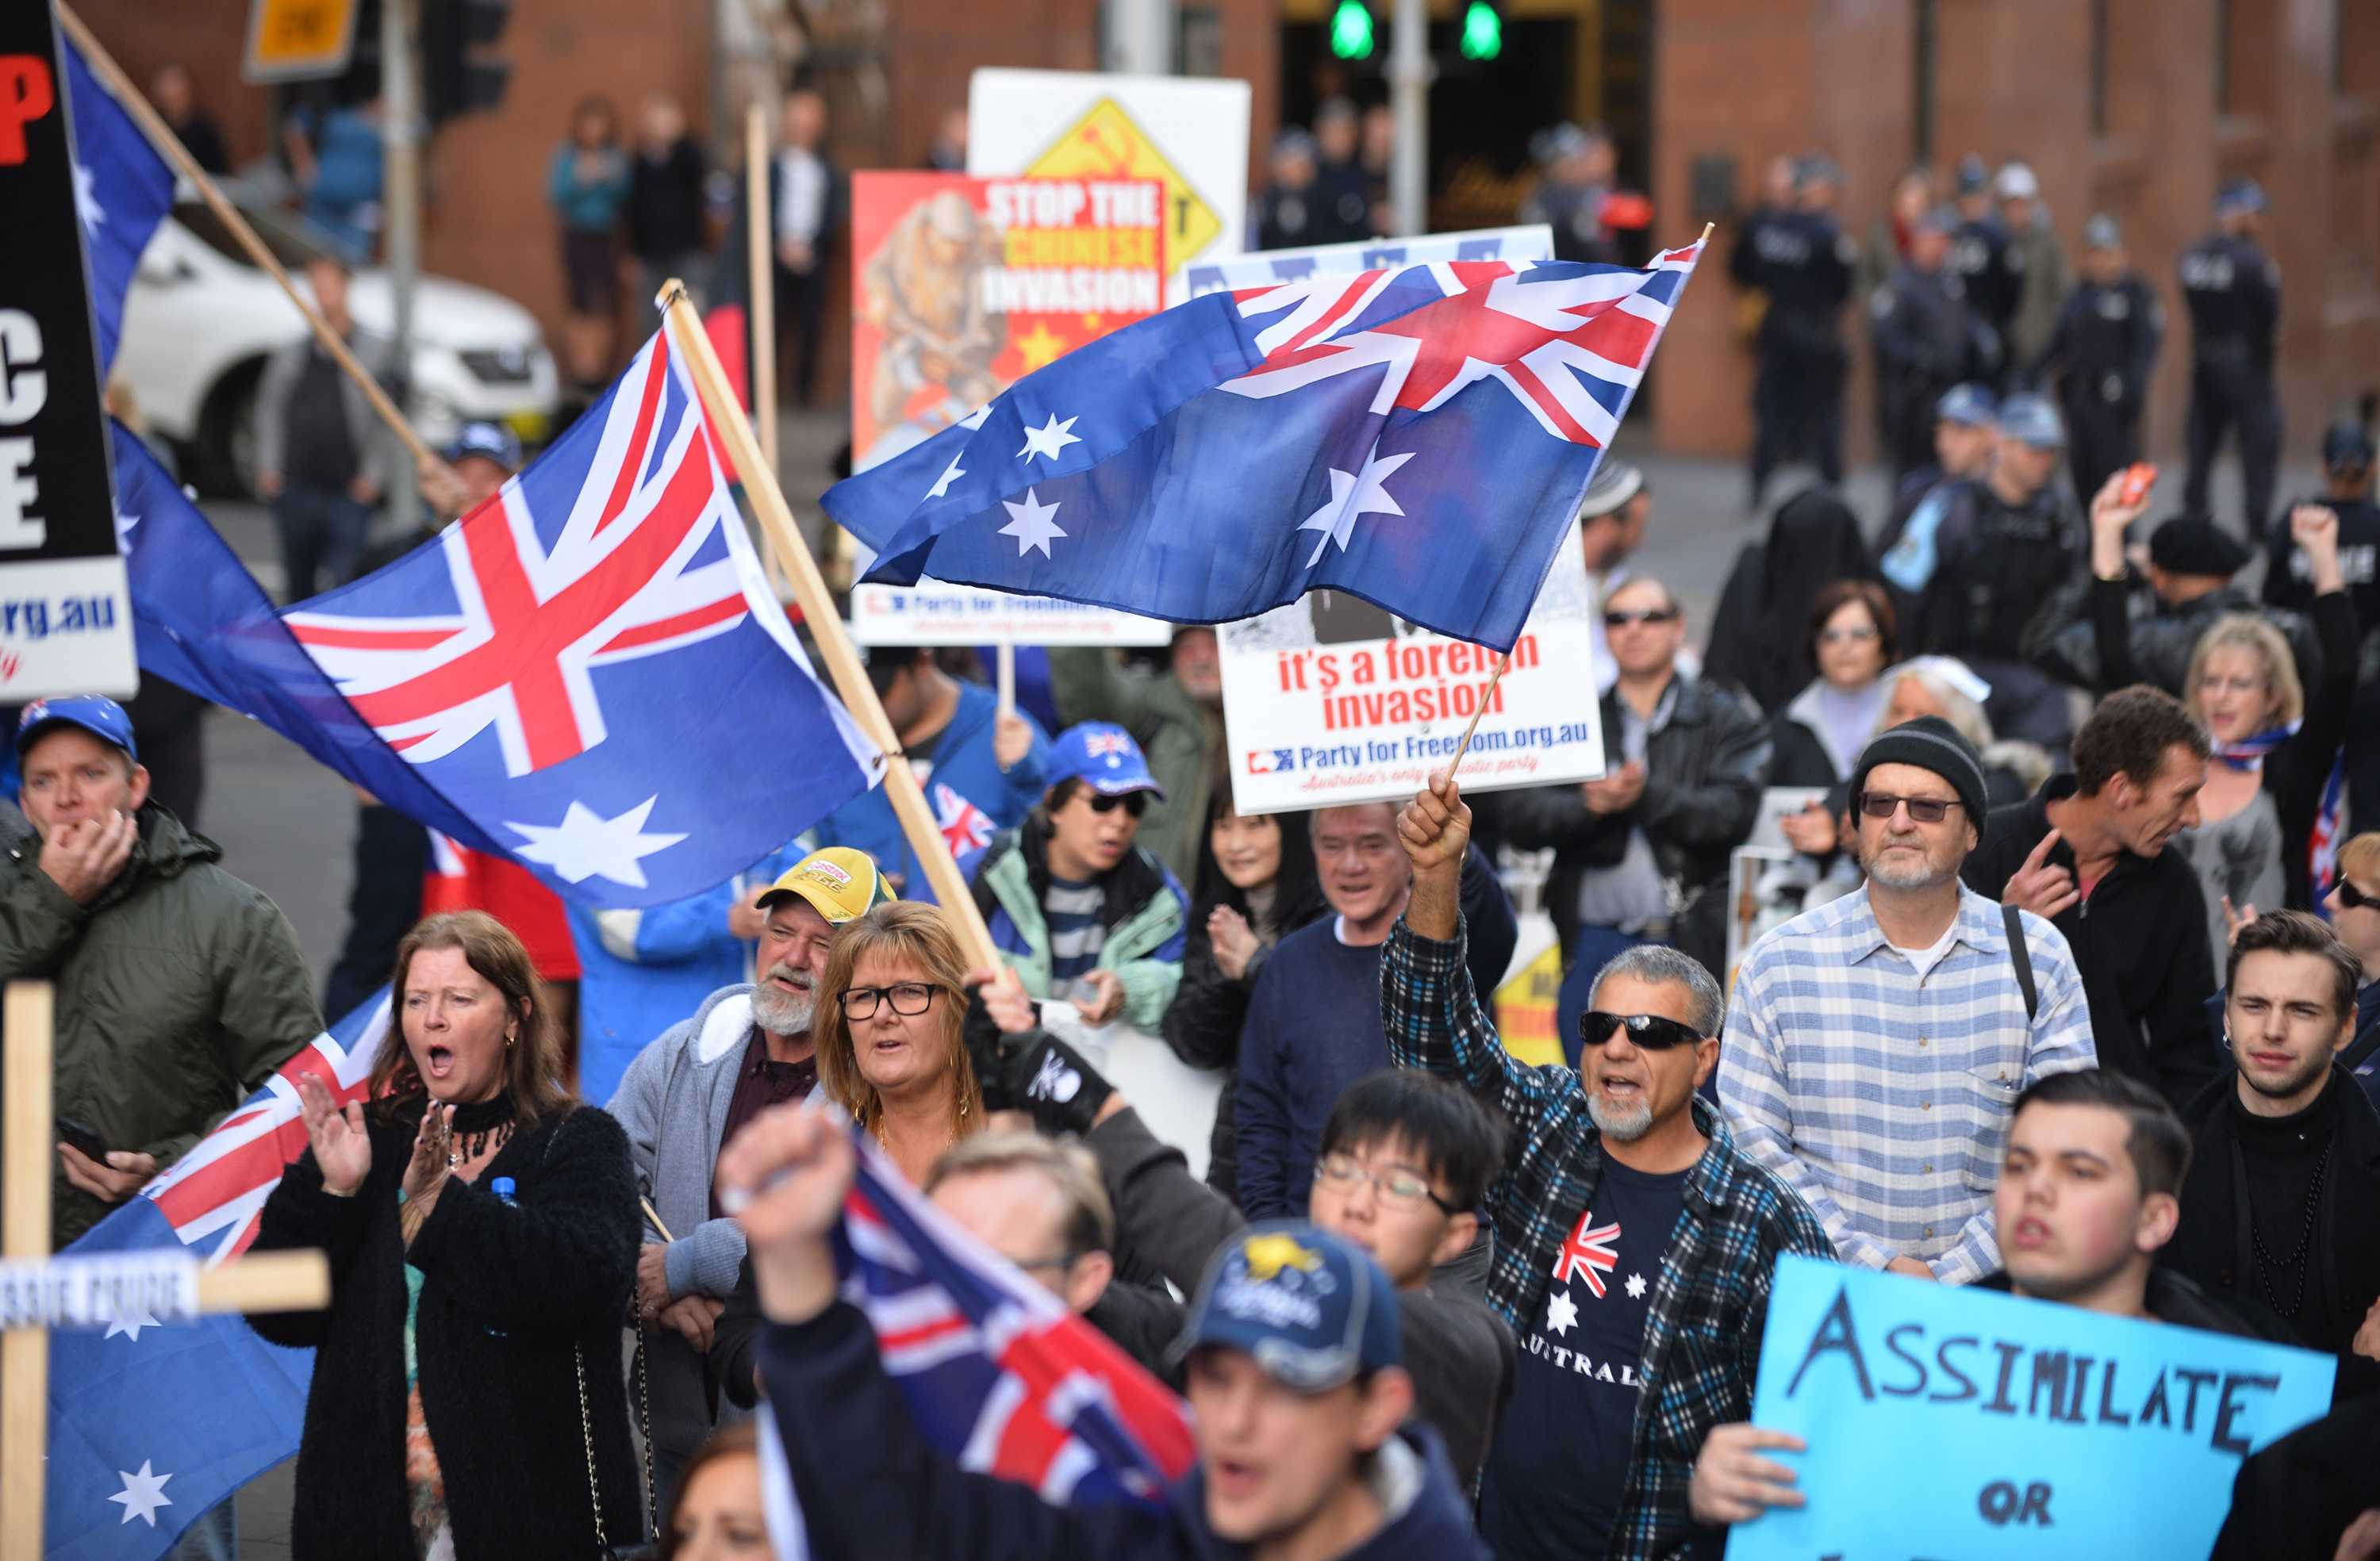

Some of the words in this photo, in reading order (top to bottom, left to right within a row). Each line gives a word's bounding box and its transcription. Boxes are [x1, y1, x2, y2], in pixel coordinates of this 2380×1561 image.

[985, 182, 1086, 227] STOP
[1089, 181, 1160, 225] THE
[1005, 227, 1159, 267] CHINESE
[983, 267, 1158, 313] INVASION
[0, 596, 115, 639] rg.au
[1278, 649, 1341, 692] it's
[1352, 650, 1376, 685] a
[1322, 677, 1504, 730] invasion
[1301, 744, 1361, 769] Party
[1368, 740, 1399, 762] for
[1521, 1333, 1640, 1387] USTRAL
[1786, 1284, 2282, 1458] ASSIMILATE
[1977, 1480, 2056, 1528] OR
